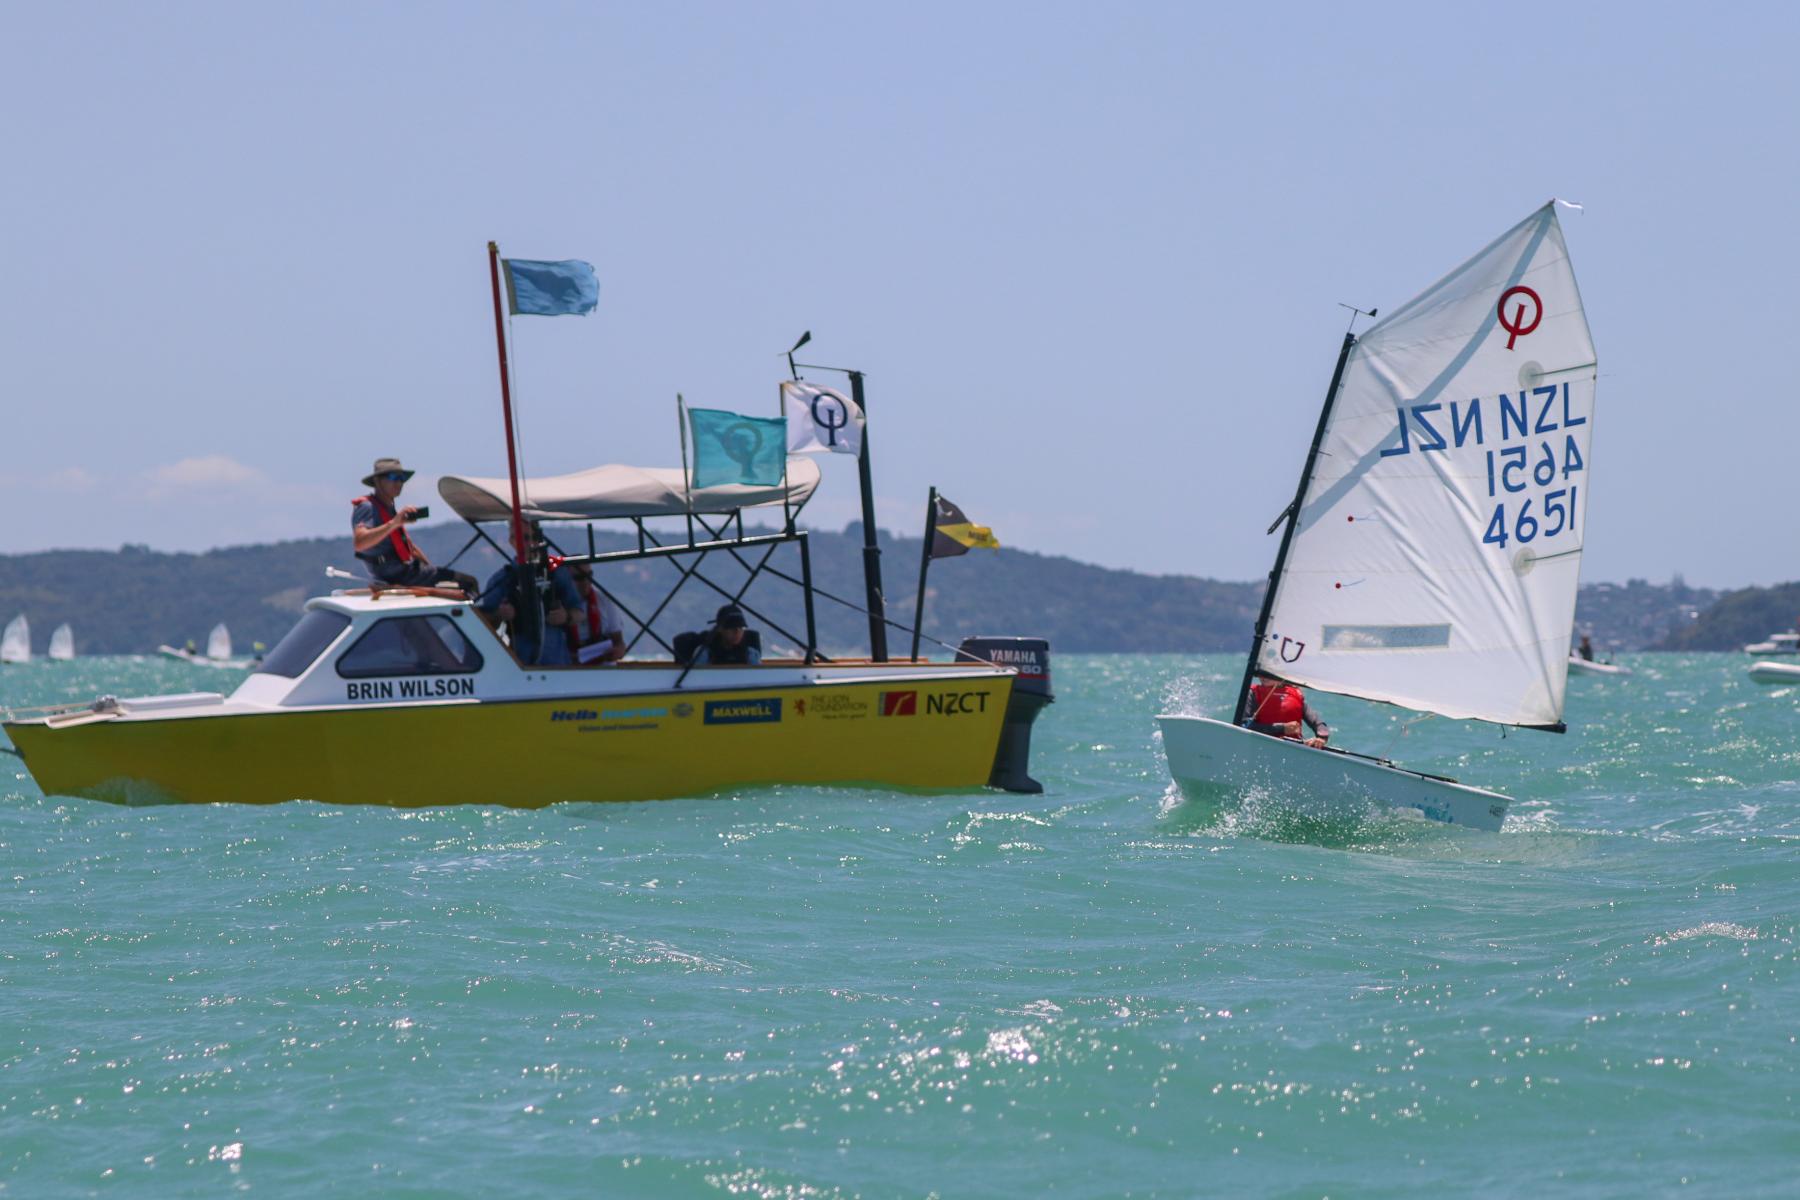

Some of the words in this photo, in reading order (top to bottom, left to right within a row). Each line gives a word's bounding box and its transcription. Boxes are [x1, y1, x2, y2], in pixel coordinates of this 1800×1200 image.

[1498, 381, 1587, 441] NZL
[1482, 485, 1577, 549] 4651
[989, 649, 1037, 664] YAMAHA
[347, 681, 393, 700] BRIN
[399, 678, 474, 698] WILSON
[712, 704, 773, 718] MAXWELL
[926, 691, 991, 715] NZCT
[551, 709, 599, 722] Hella
